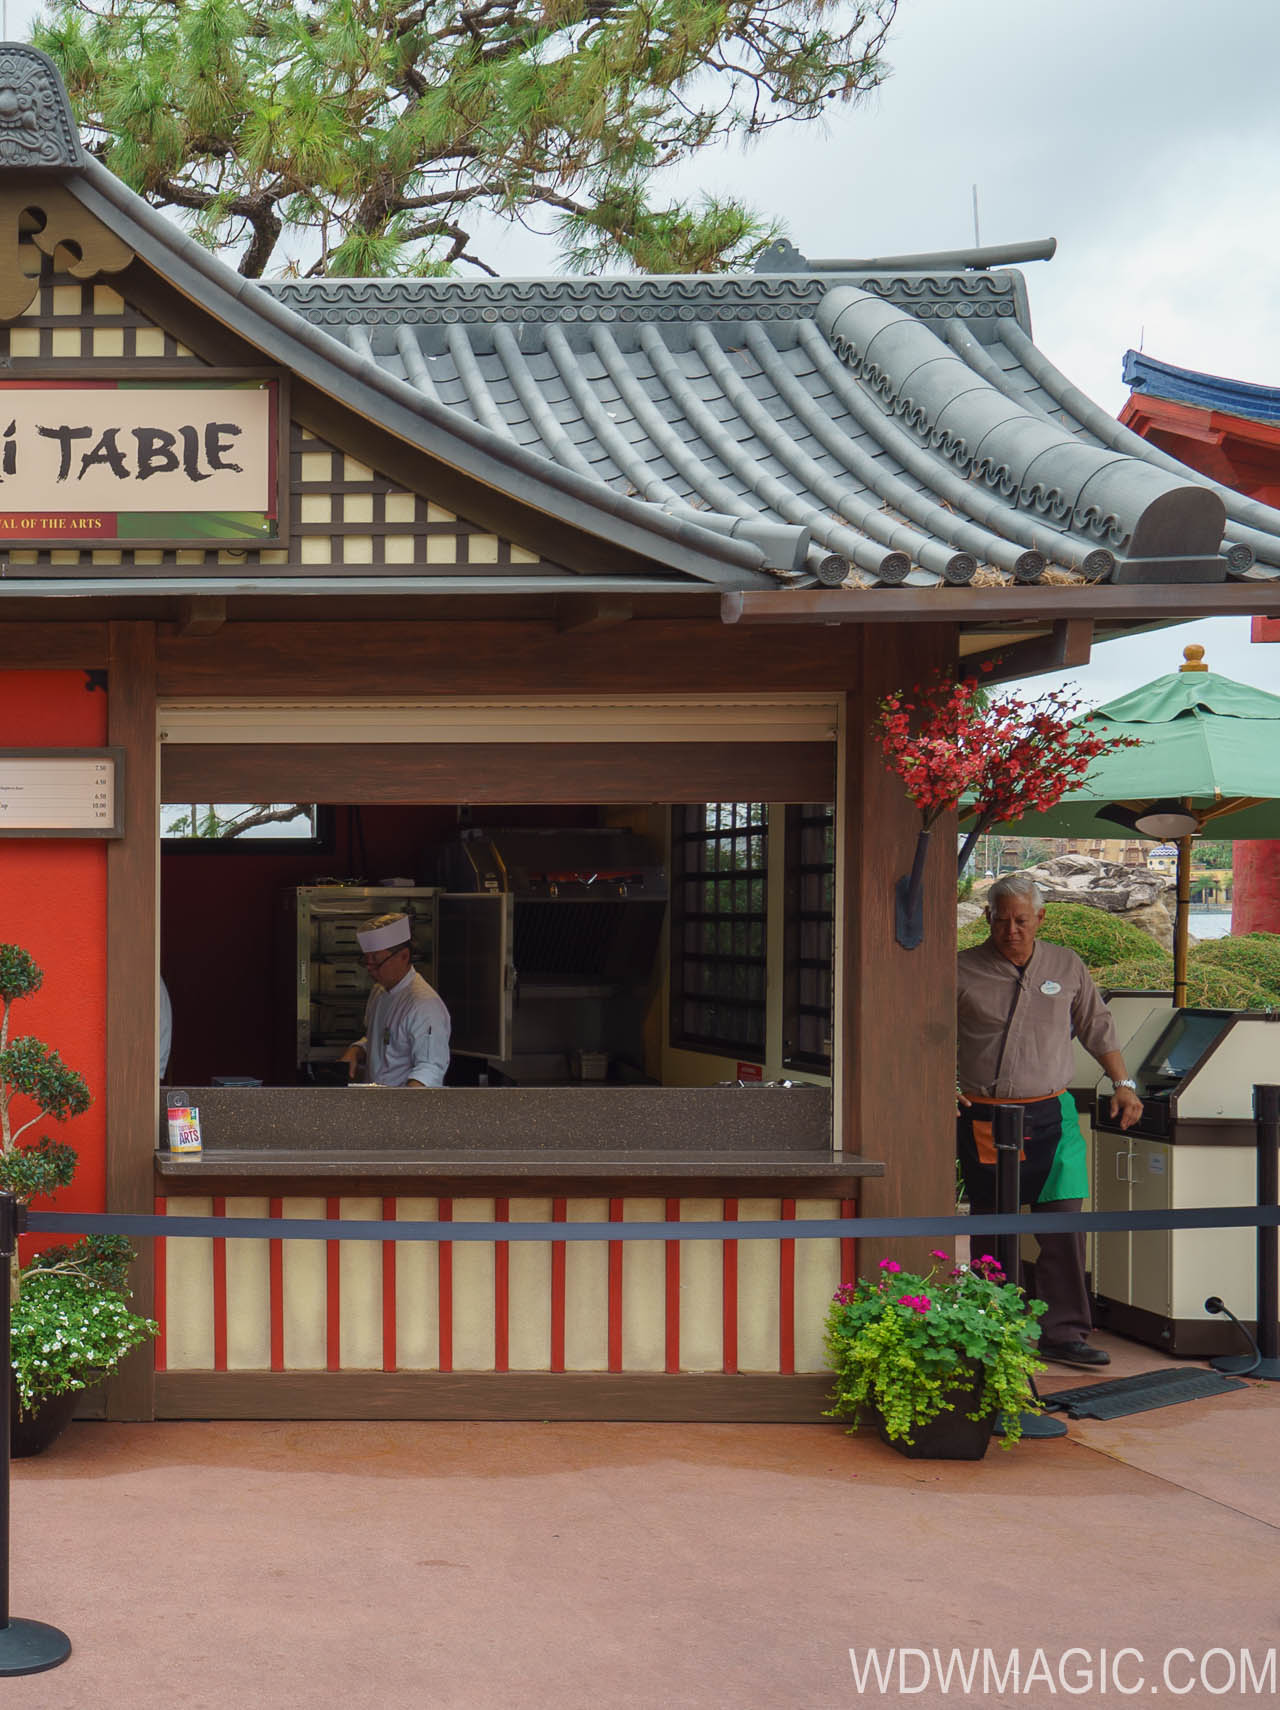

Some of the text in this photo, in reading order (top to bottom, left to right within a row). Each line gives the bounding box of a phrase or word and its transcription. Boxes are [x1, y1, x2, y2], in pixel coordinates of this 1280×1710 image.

[35, 422, 244, 484] TABLE
[21, 519, 37, 529] OF
[41, 519, 67, 529] THE
[70, 519, 102, 529] ARTS
[179, 1129, 200, 1145] ARTS
